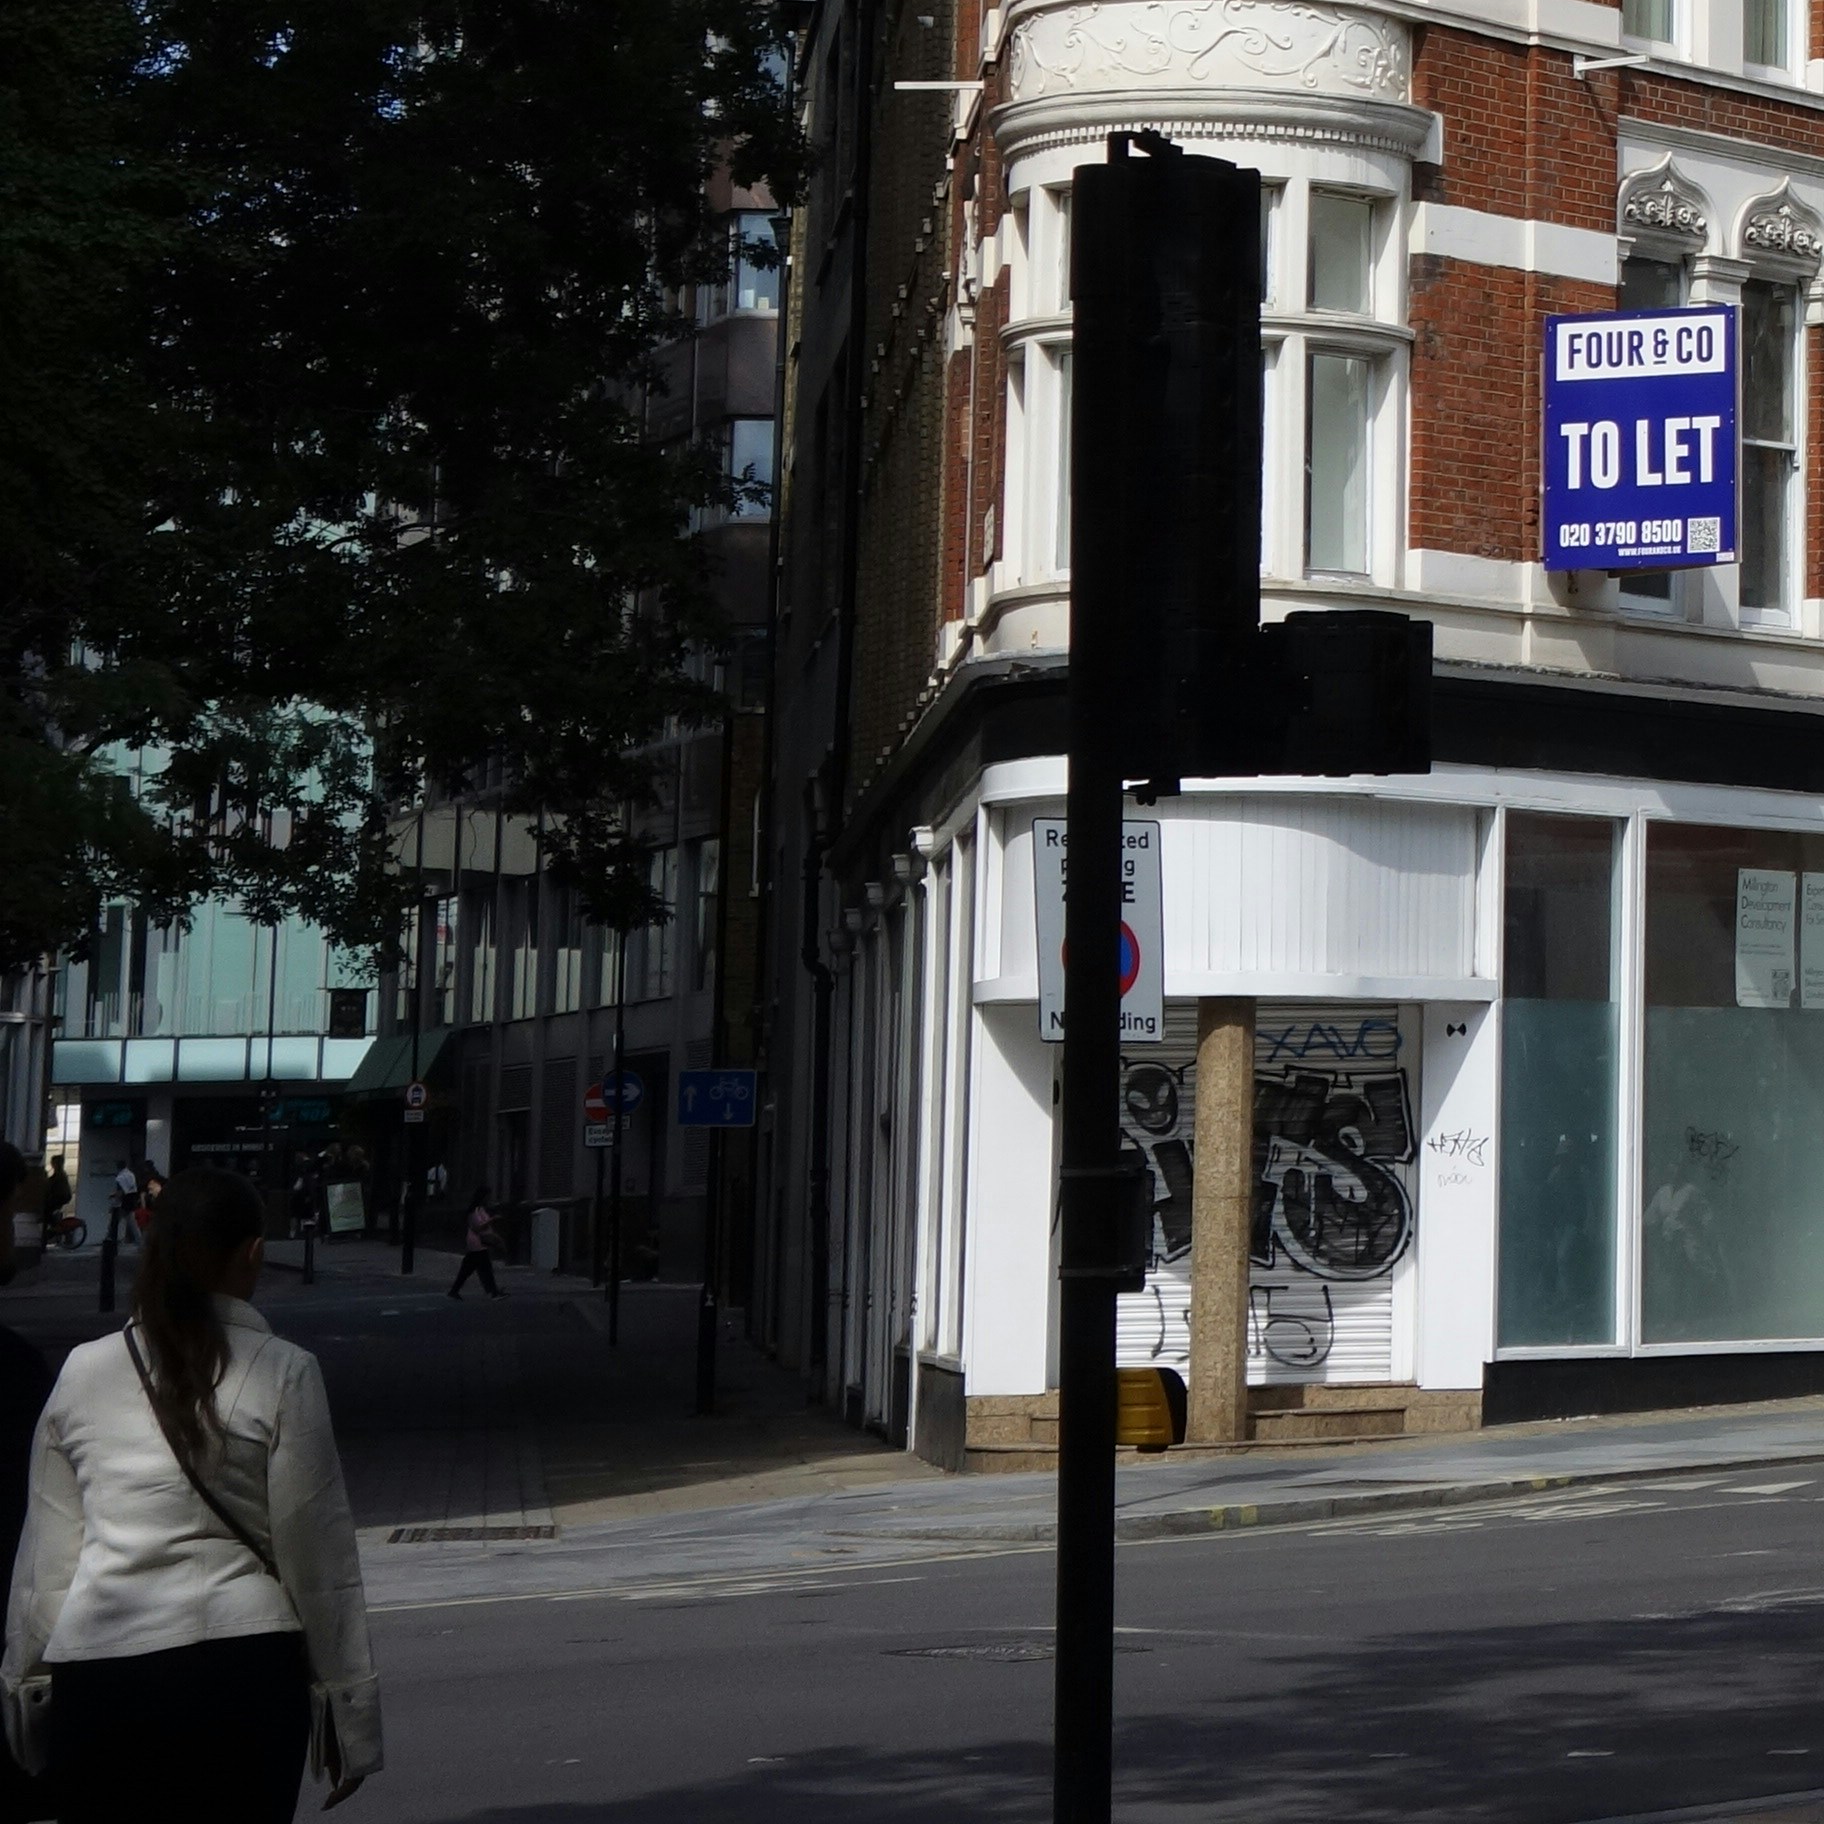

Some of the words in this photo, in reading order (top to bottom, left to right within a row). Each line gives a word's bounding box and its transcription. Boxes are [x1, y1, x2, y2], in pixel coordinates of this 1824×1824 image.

[1567, 330, 1645, 370] FOUR
[1652, 328, 1669, 366] &
[1675, 324, 1714, 364] CO
[1560, 420, 1621, 490] TO
[1635, 415, 1721, 487] LET
[1559, 523, 1591, 548] 020
[1594, 521, 1637, 546] 3790
[1641, 518, 1682, 544] 8500
